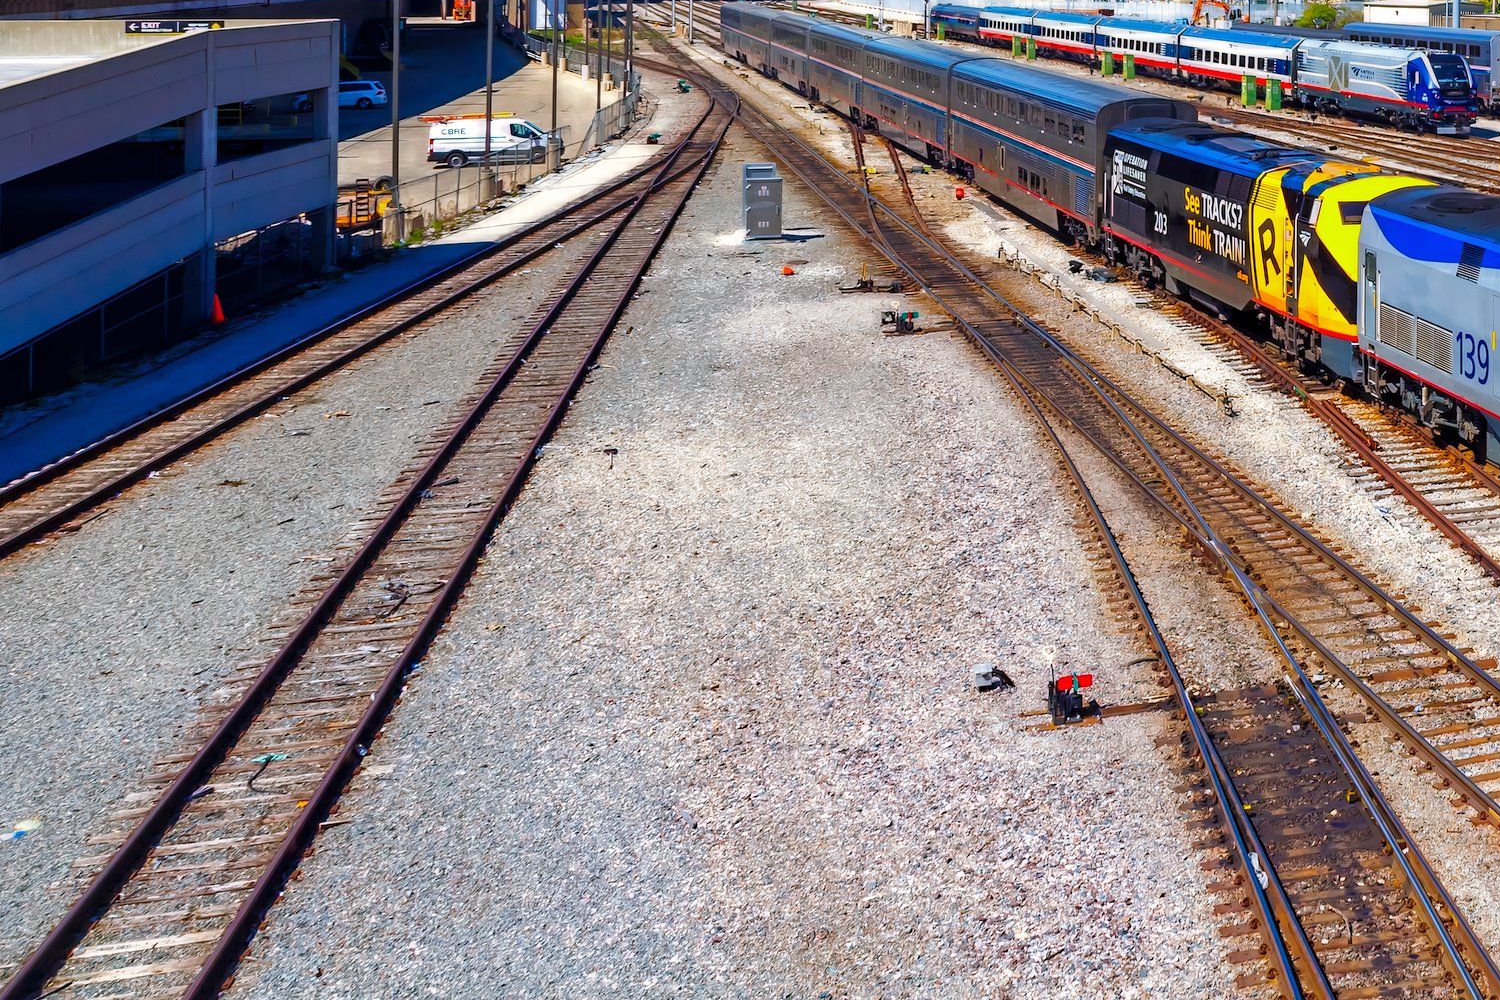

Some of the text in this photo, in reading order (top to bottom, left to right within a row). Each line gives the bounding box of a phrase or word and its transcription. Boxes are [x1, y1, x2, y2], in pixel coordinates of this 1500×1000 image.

[1122, 164, 1147, 182] LIFESAVER
[1123, 152, 1149, 171] OPERATION
[1154, 210, 1168, 235] 203
[1184, 186, 1200, 215] See
[1201, 192, 1243, 230] TRACKS?
[1187, 219, 1246, 266] Think TRAIN!
[1258, 218, 1281, 286] R
[1456, 331, 1489, 385] 139
